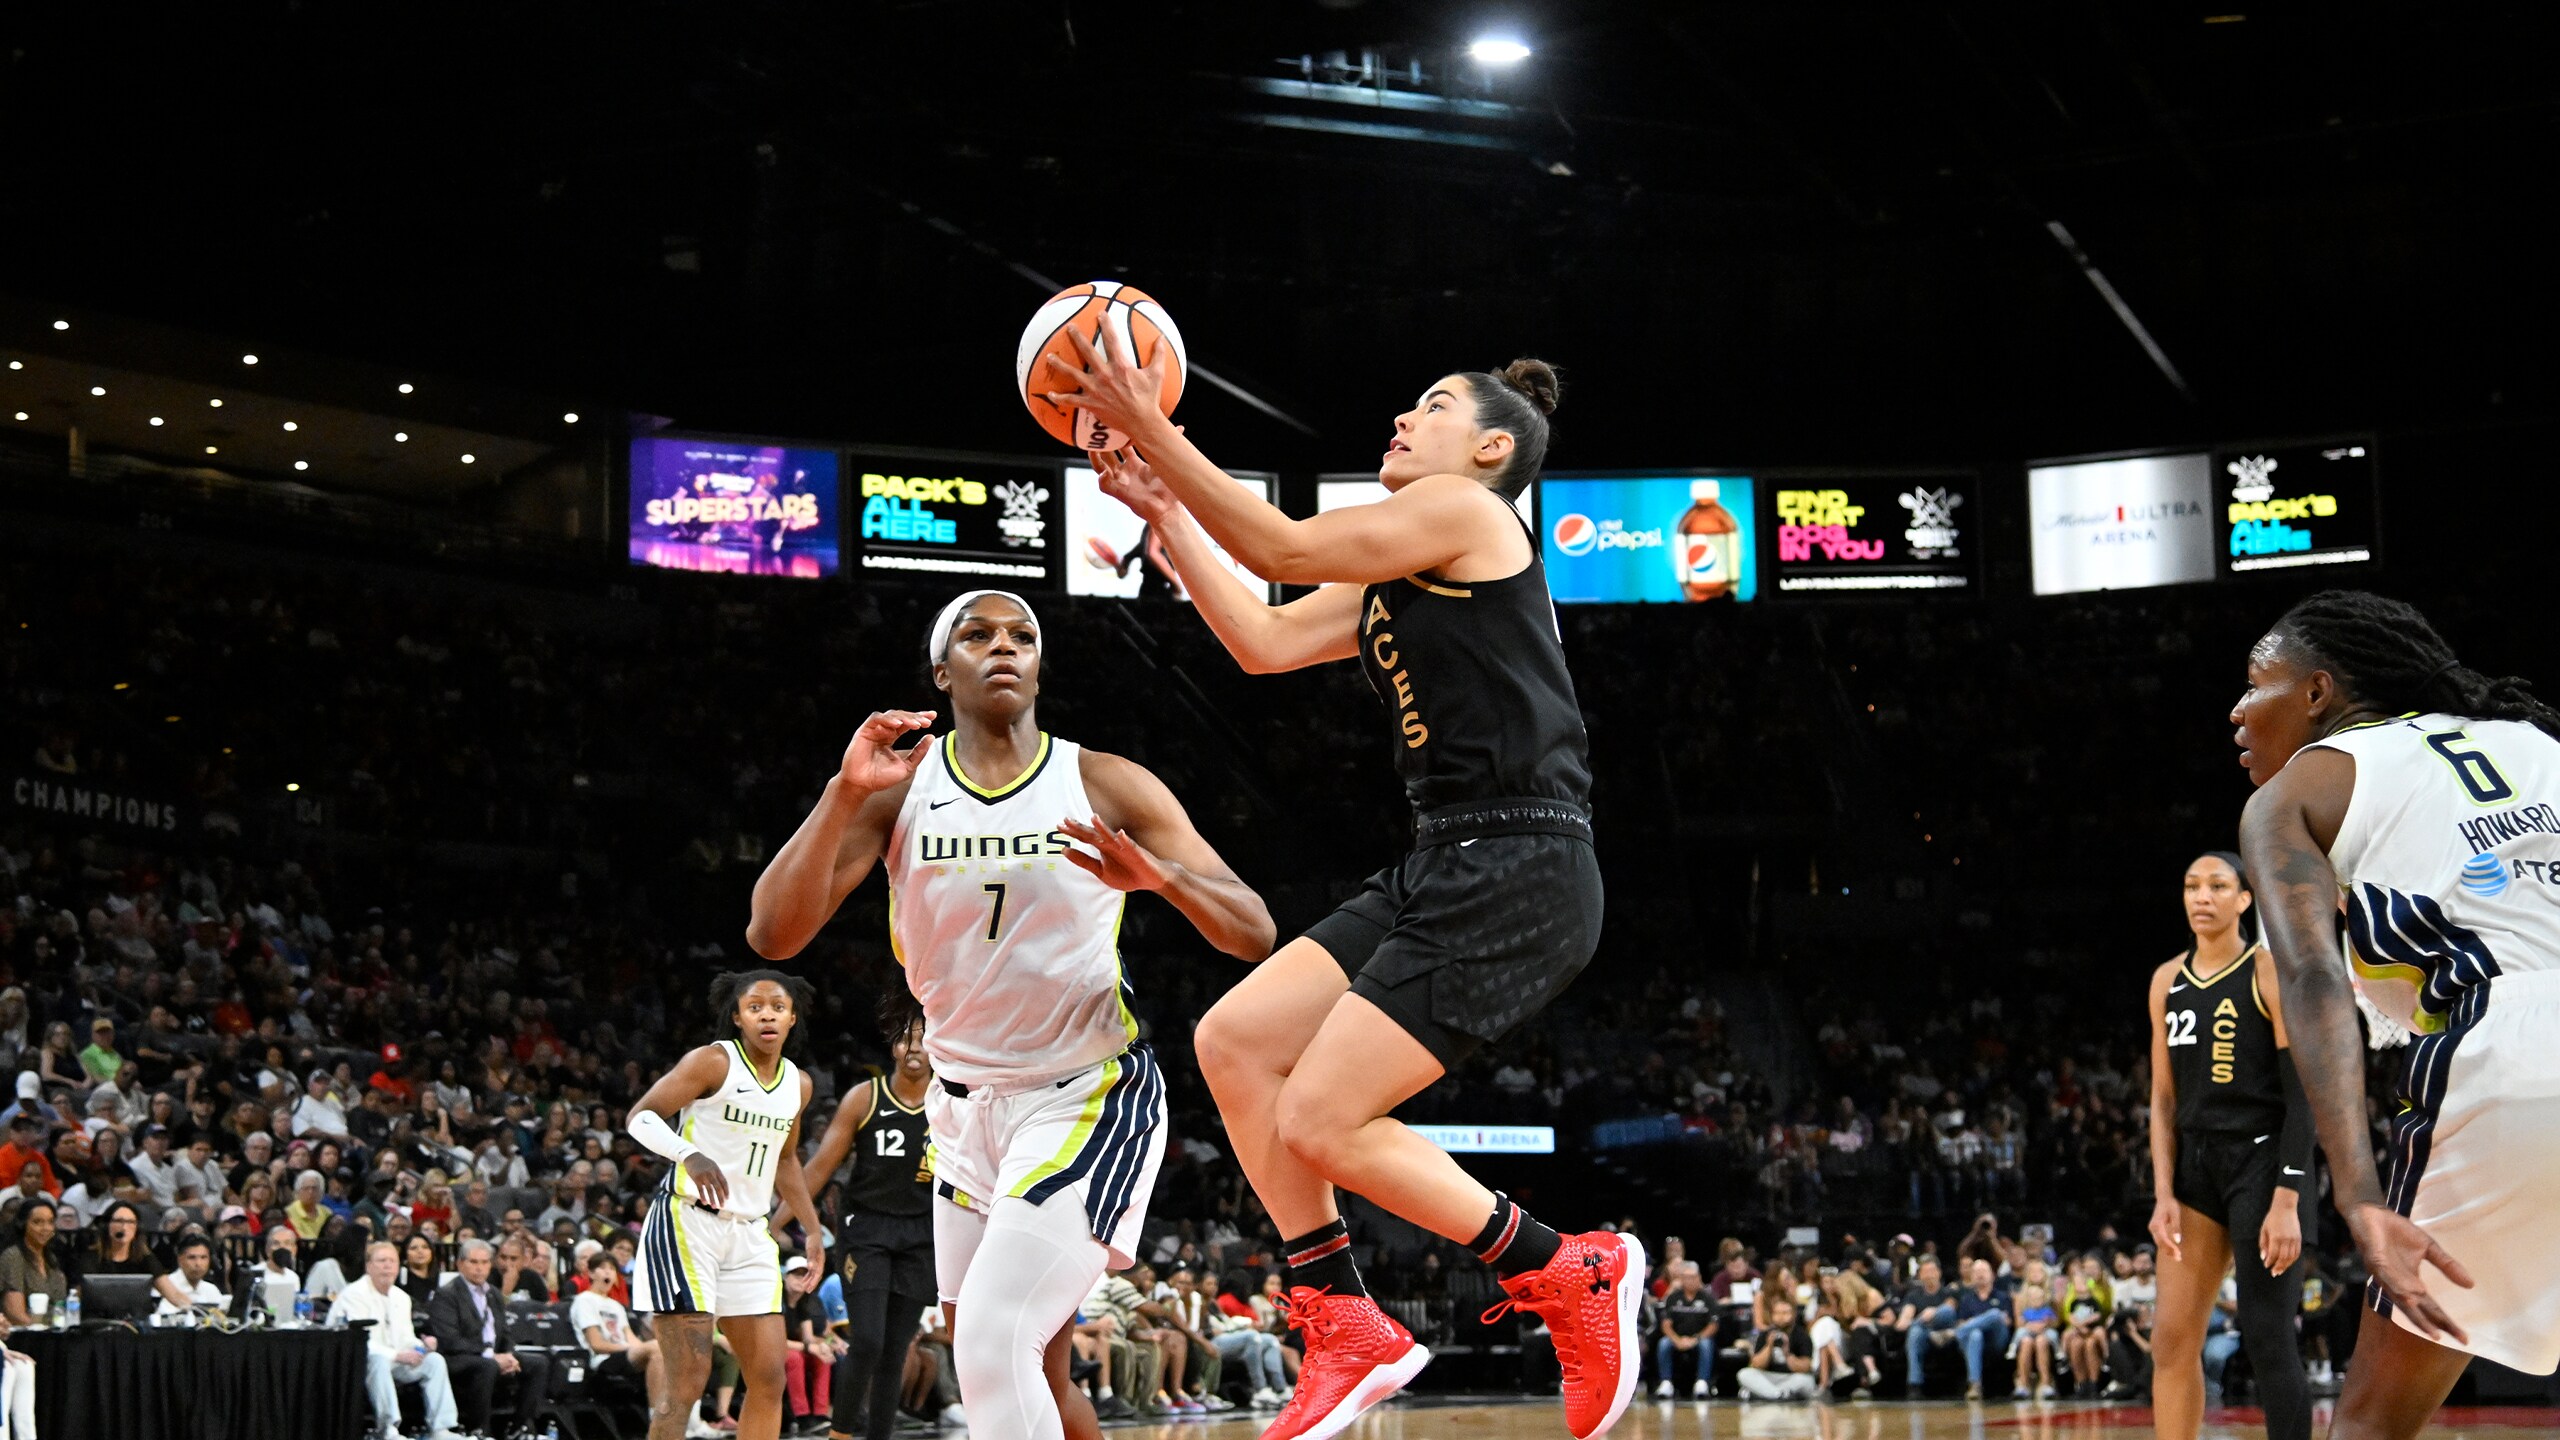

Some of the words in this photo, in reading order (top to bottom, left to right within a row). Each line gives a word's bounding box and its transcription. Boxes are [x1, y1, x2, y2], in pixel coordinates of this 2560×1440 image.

[861, 473, 987, 505] PACK'S
[1777, 489, 1848, 517] FIND
[646, 493, 818, 526] SUPERSTARS
[864, 495, 934, 519] ALL
[1784, 506, 1865, 527] THAT
[862, 515, 957, 544] HERE
[1780, 542, 1811, 561] IN
[1821, 539, 1885, 561] YOU
[1365, 594, 1429, 749] ACES
[2425, 729, 2515, 804] 6
[14, 777, 177, 831] CHAMPIONS
[2458, 803, 2560, 855] HOWARD
[920, 829, 1072, 862] WINGS
[2513, 859, 2560, 885] AT&
[983, 883, 1006, 941] 7
[2165, 1009, 2197, 1047] 22
[2211, 998, 2239, 1084] ACES
[723, 1103, 795, 1133] WINGS
[875, 1129, 905, 1157] 12
[1488, 1132, 1541, 1146] ARENA
[746, 1141, 768, 1177] 11
